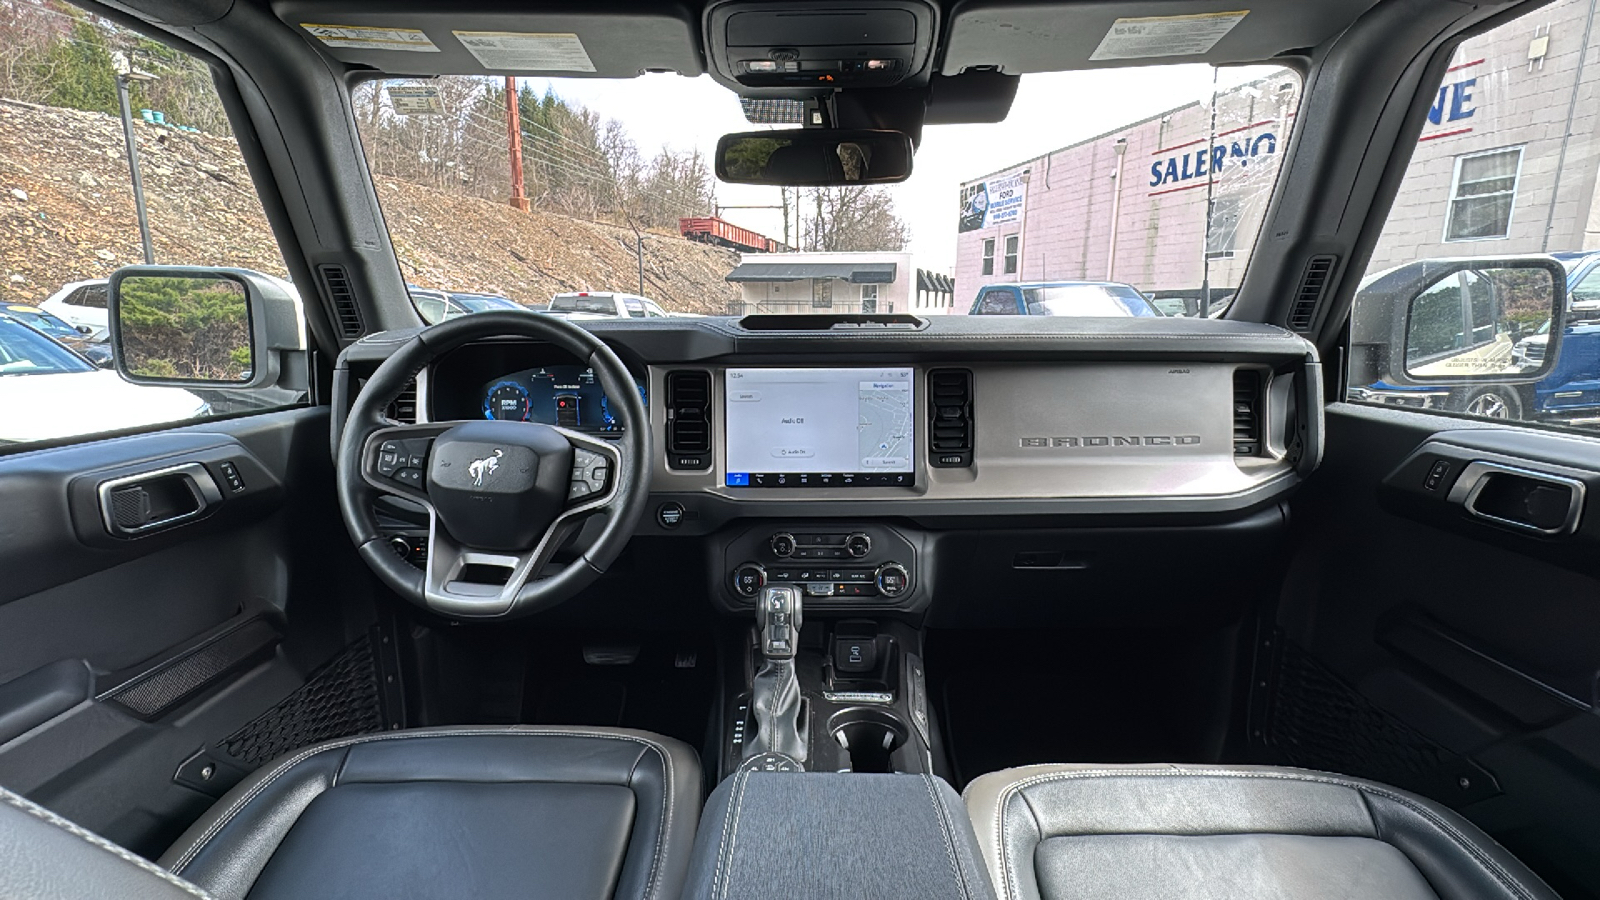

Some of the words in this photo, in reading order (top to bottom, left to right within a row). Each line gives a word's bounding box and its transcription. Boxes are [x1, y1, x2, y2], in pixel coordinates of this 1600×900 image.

[1150, 132, 1277, 188] SALERNO
[999, 189, 1014, 200] FORD
[1019, 434, 1201, 448] BRONCO
